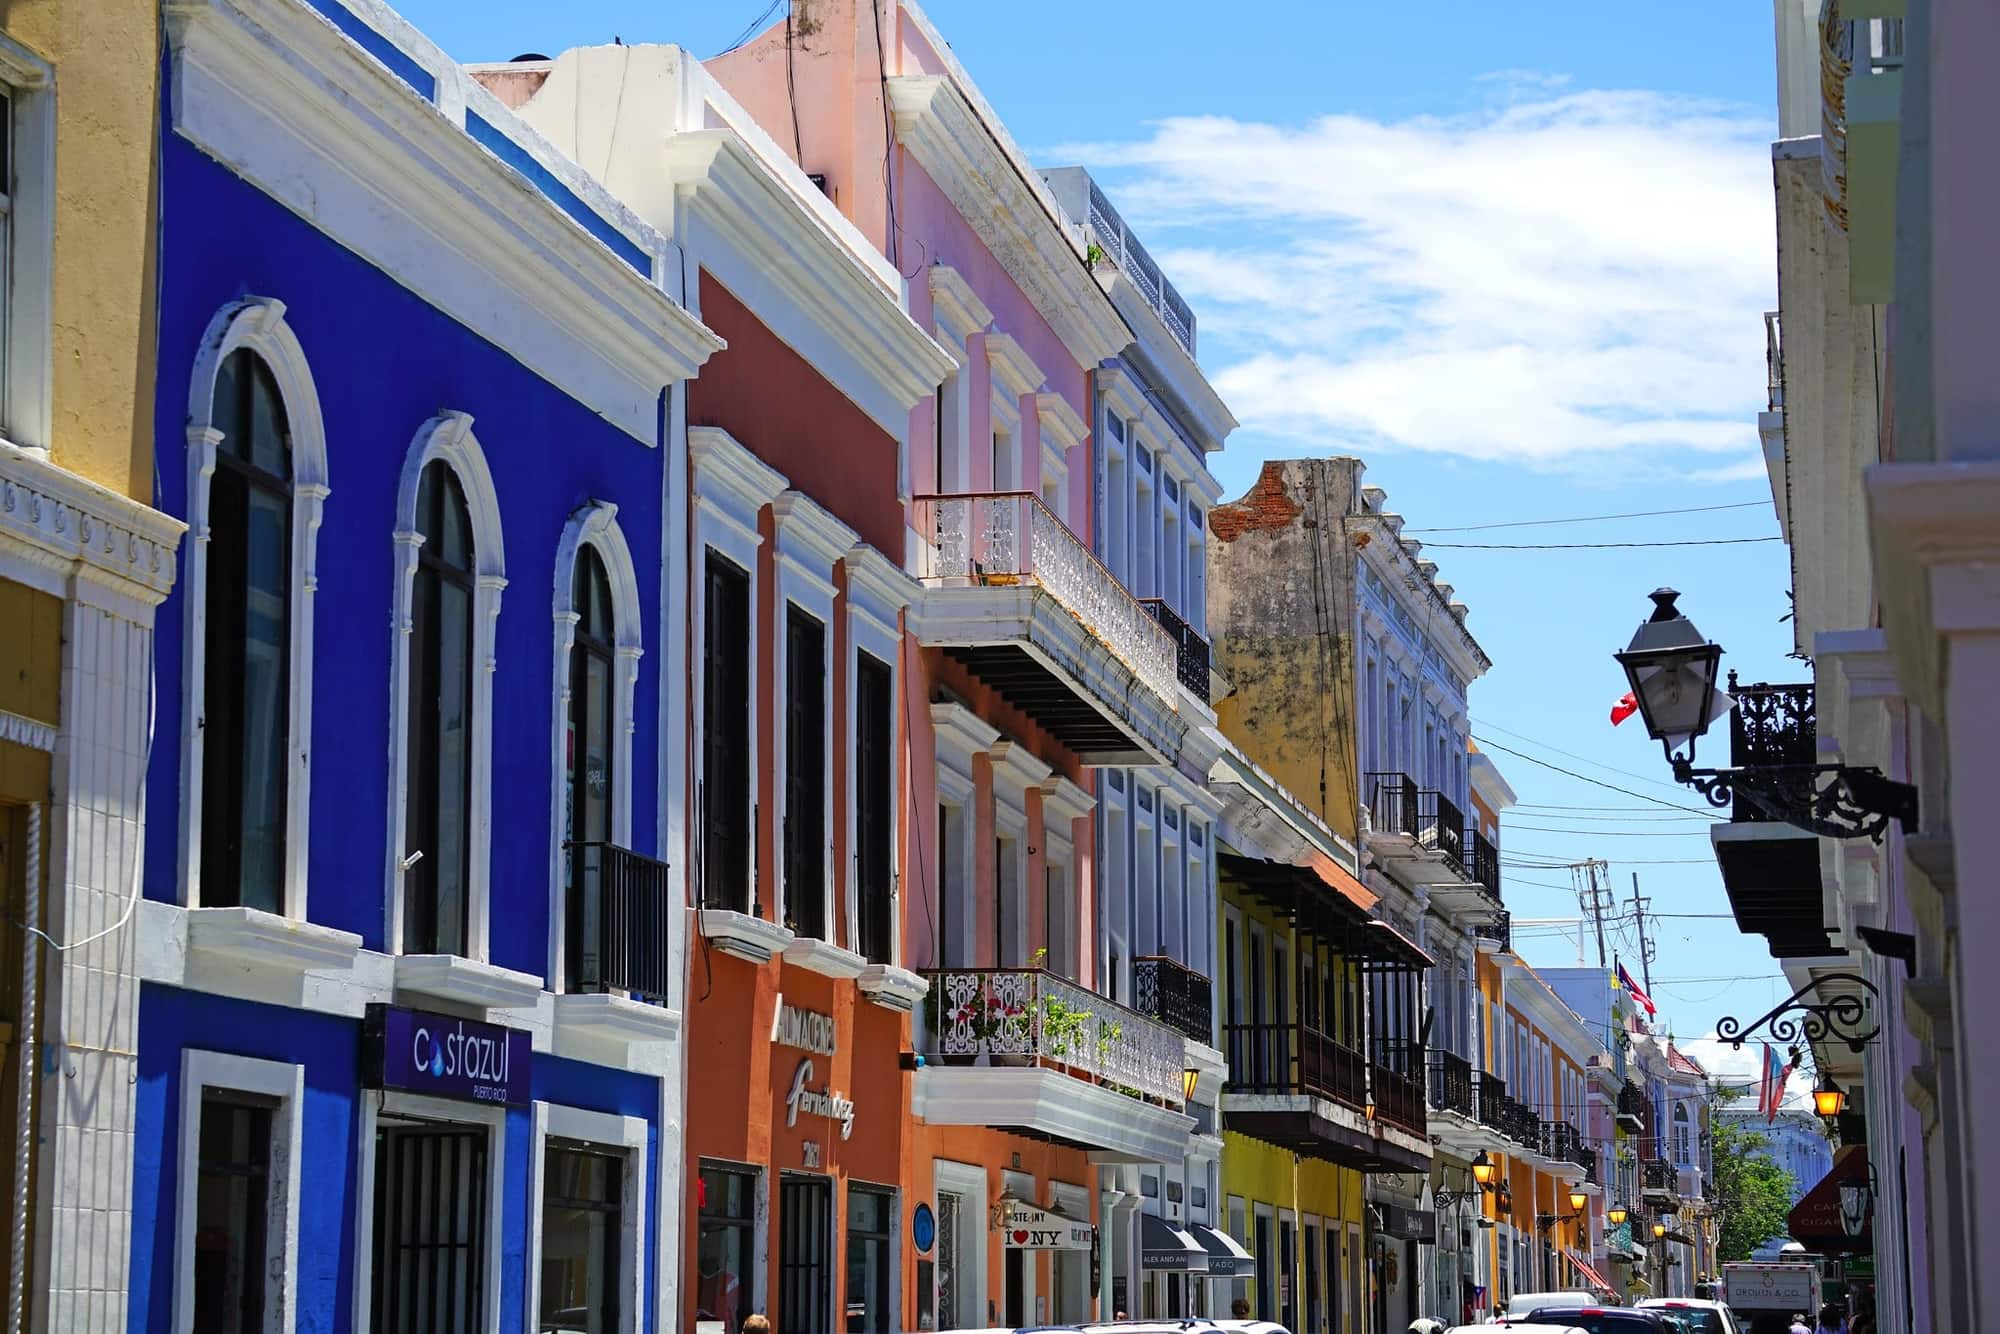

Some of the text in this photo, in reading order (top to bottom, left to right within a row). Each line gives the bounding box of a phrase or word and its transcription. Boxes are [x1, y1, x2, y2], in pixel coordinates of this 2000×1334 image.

[771, 992, 837, 1056] ALMACENES
[473, 1085, 507, 1102] PUERTO RICO
[1005, 1230, 1012, 1245] I
[1030, 1231, 1062, 1246] NY
[1143, 1255, 1159, 1264] ALEX
[1160, 1255, 1175, 1264] AND
